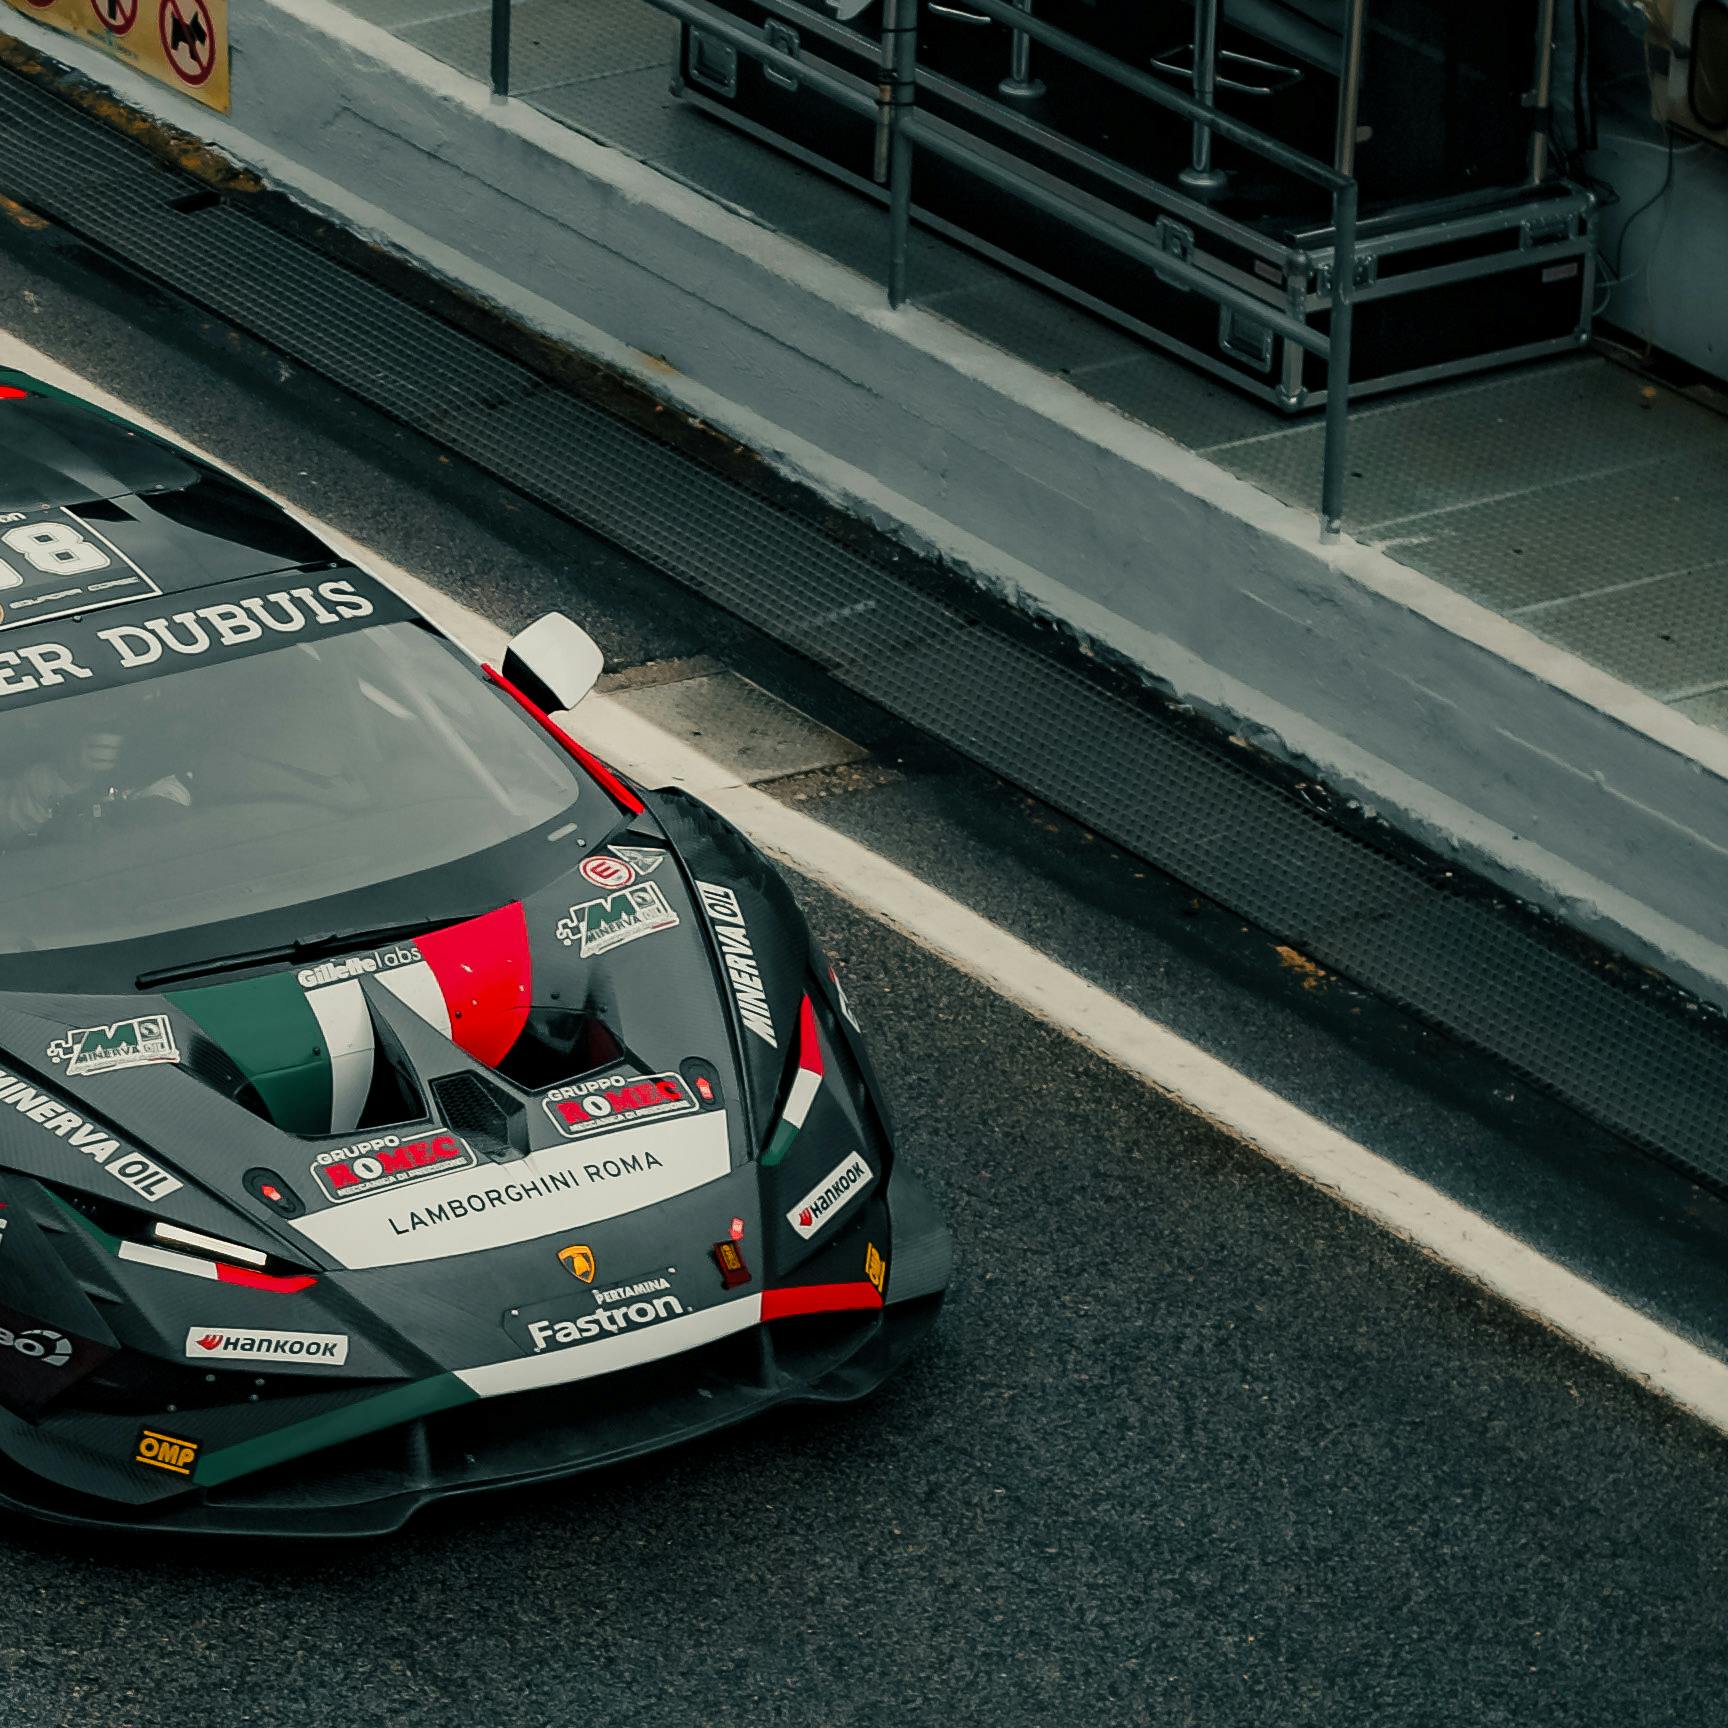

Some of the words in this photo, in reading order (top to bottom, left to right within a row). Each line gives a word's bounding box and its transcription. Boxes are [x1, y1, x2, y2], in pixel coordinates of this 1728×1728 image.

[97, 579, 374, 669] DUBUIS
[704, 890, 738, 918] OIL
[715, 925, 778, 1049] MINERVA
[548, 1075, 626, 1102] GRUPPO
[557, 1081, 683, 1125] ROMEC
[316, 1135, 400, 1165] GRUPPO
[325, 1136, 460, 1190] ROMEC
[117, 1160, 169, 1196] OIL
[387, 1168, 579, 1237] LAMBORGHINI
[586, 1150, 664, 1184] ROMA
[595, 1277, 670, 1305] PERTAMINA
[527, 1294, 684, 1349] Fastron
[139, 1437, 195, 1467] OMP
